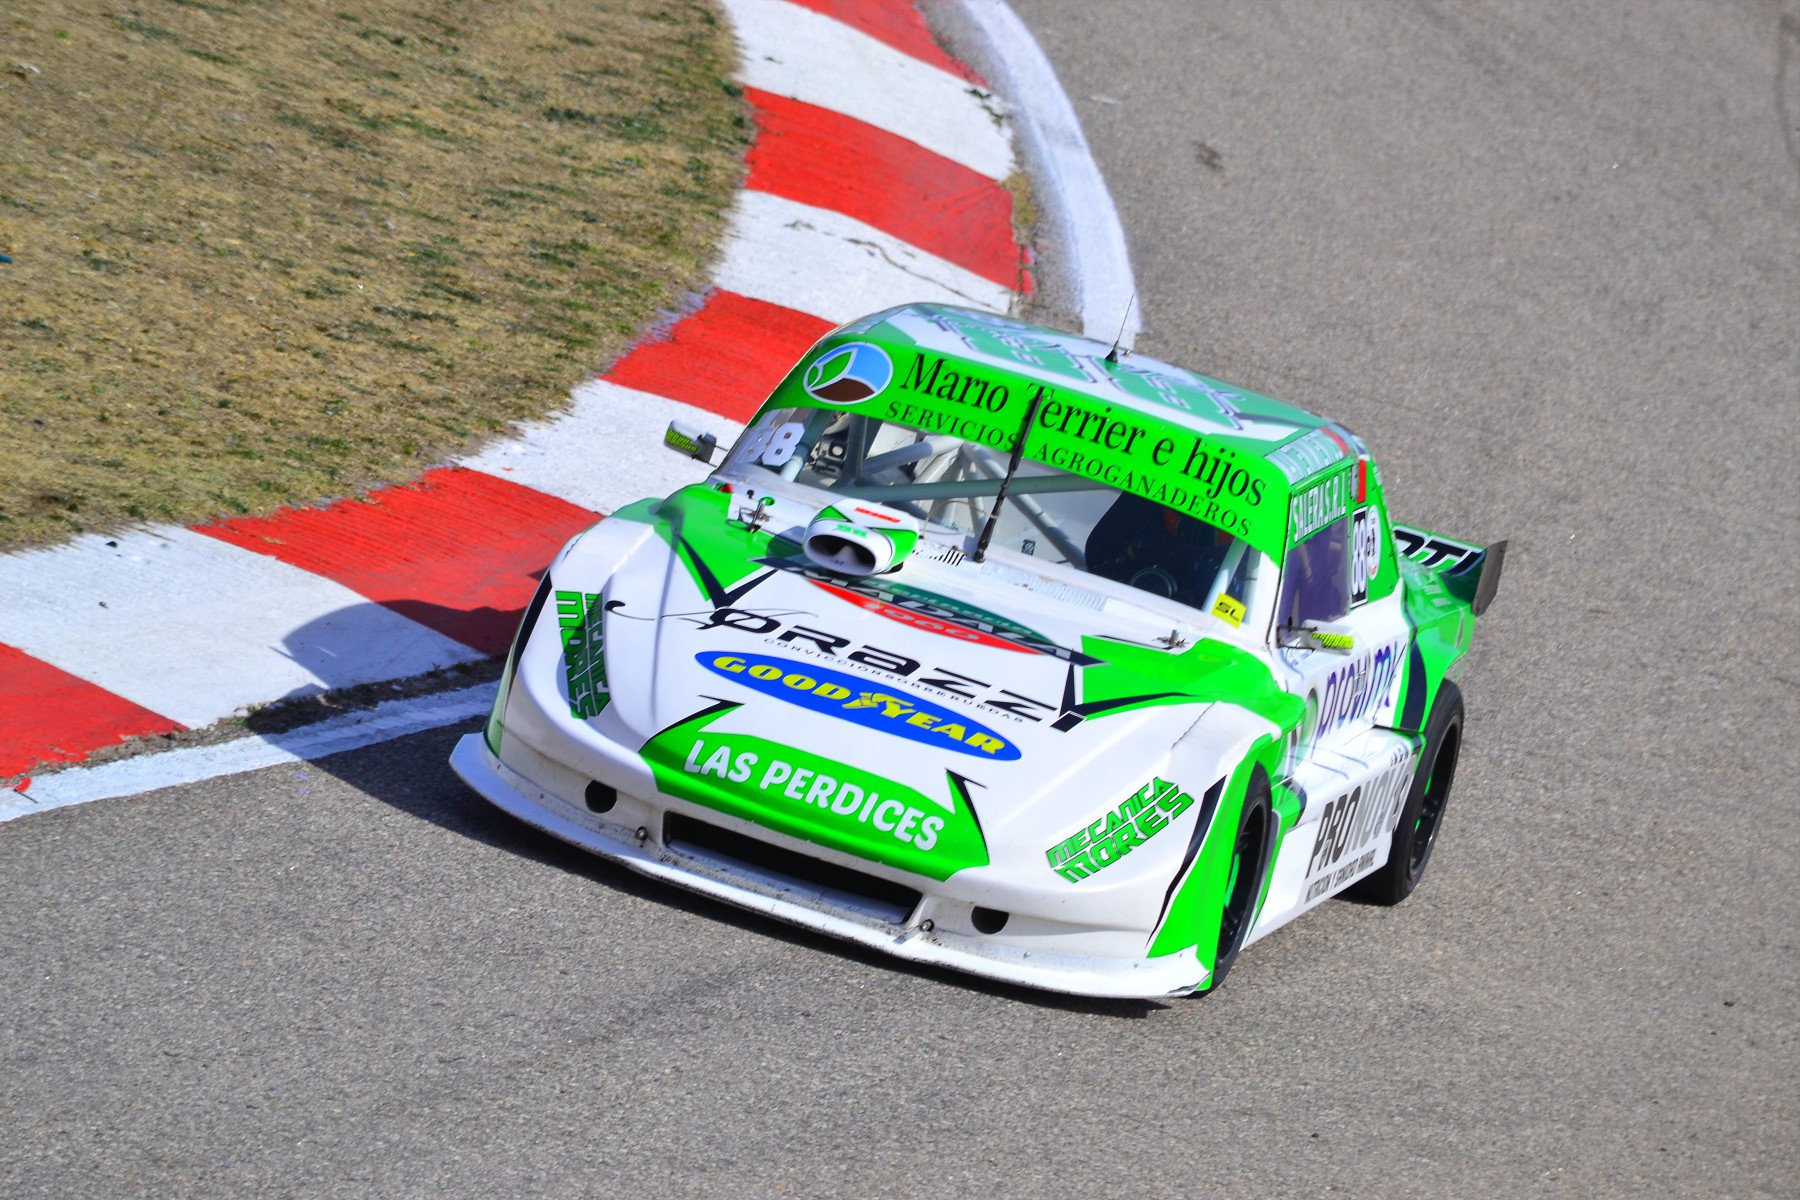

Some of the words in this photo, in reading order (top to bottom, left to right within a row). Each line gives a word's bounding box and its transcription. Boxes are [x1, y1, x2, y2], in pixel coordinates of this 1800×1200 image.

[885, 401, 1019, 452] SERVICIOS
[1033, 442, 1254, 537] AGROGANADEROS
[900, 352, 1010, 414] Mario
[1027, 381, 1146, 456] Terrier
[1152, 435, 1175, 467] e
[1180, 437, 1267, 507] hijos
[1351, 518, 1366, 596] 88
[555, 590, 592, 720] MORES
[1216, 601, 1241, 623] SL
[712, 655, 1005, 755] GOODYEAR
[684, 739, 756, 783] LAS
[758, 760, 945, 851] PERDICES
[1045, 776, 1175, 868] MECANICA
[1054, 785, 1194, 883] MORES
